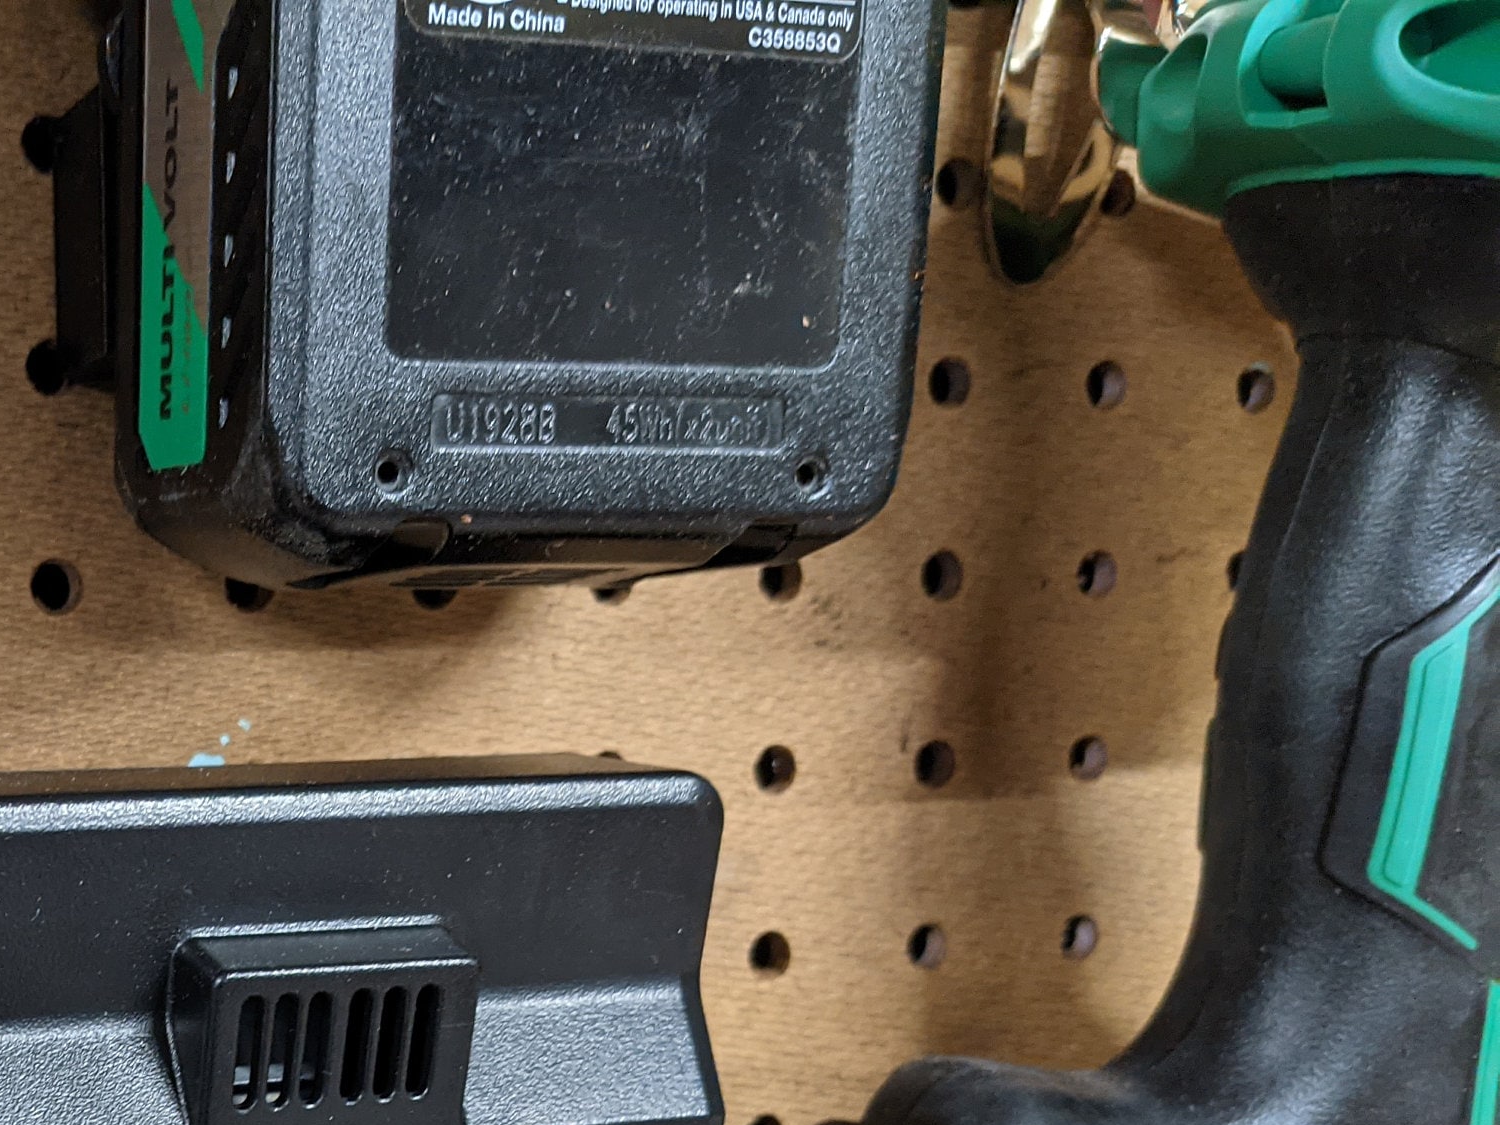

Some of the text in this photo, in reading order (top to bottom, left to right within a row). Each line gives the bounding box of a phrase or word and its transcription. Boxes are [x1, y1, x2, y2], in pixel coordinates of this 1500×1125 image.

[427, 2, 482, 27] Made
[510, 8, 565, 33] China
[657, 0, 716, 22] operating
[735, 1, 762, 21] USA
[765, 2, 774, 23] &
[778, 3, 824, 26] Canada
[828, 7, 854, 32] only
[445, 401, 556, 445] U1928B
